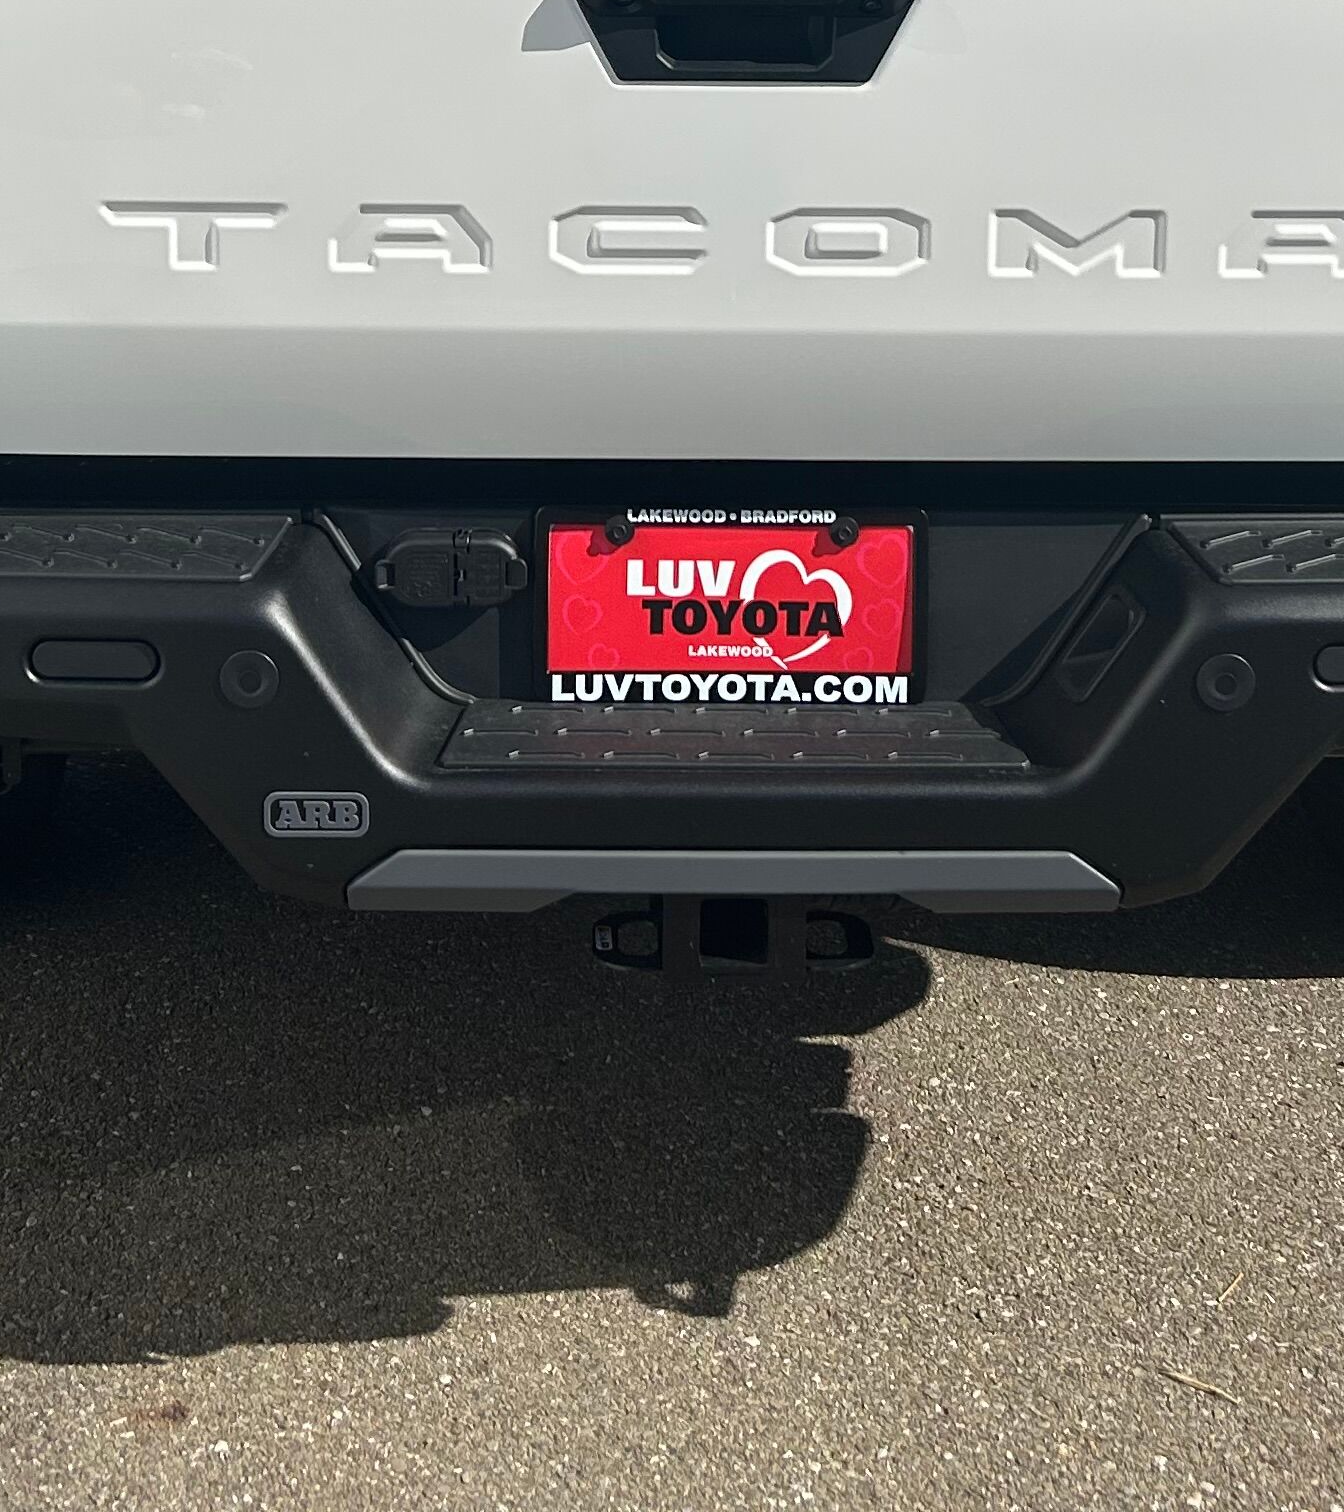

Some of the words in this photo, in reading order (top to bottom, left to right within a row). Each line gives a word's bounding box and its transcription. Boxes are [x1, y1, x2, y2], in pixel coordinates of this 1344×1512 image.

[626, 508, 727, 524] LAKEWOOD
[740, 509, 837, 525] BRADFORD
[626, 559, 736, 597] LUV
[641, 599, 844, 638] TOYOTA
[688, 644, 773, 658] LAKEWOOD
[550, 673, 909, 704] LUVTOYOTA.COM
[275, 800, 360, 829] ARB
